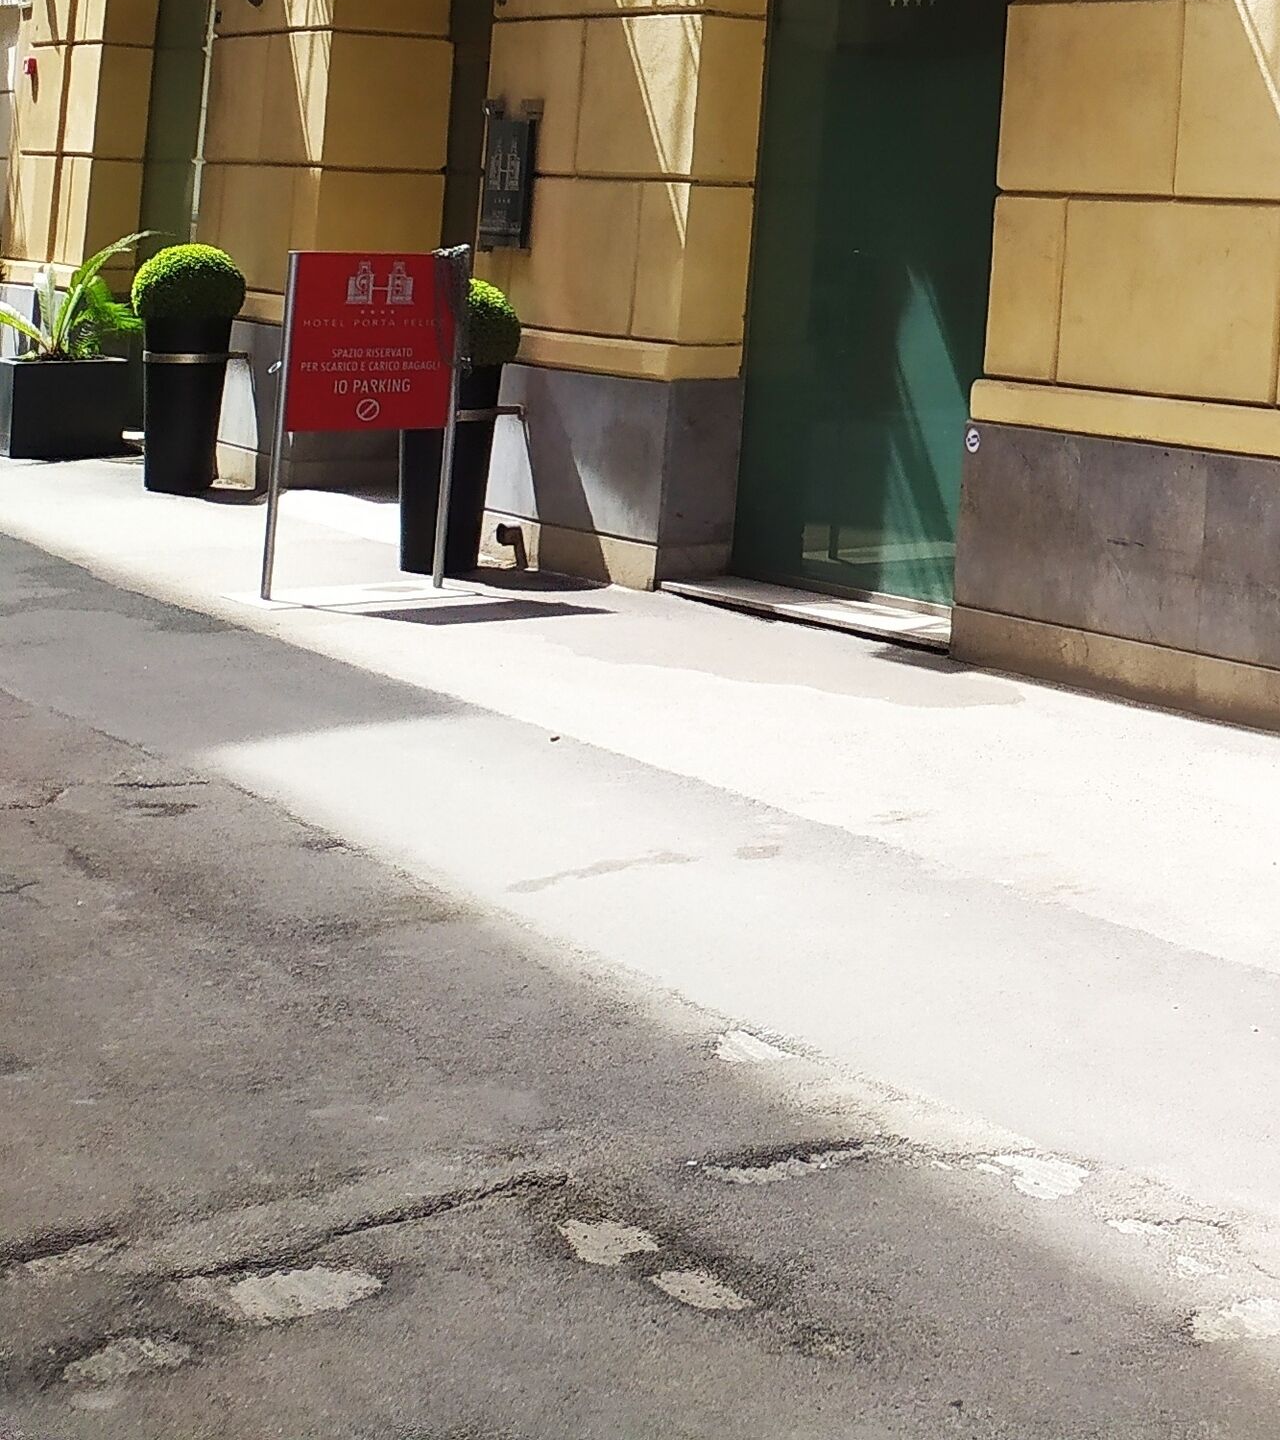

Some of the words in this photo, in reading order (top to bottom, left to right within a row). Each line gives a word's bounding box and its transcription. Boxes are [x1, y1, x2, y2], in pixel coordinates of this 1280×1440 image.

[303, 318, 345, 329] HOTEL
[353, 318, 396, 328] PORTA
[403, 317, 445, 327] FELIC
[331, 347, 364, 359] SPAZIO
[366, 346, 414, 359] RISERVATO
[300, 361, 319, 372] PER
[321, 361, 359, 372] SCARICO
[360, 361, 367, 372] E
[368, 360, 400, 372] CARICO
[402, 360, 441, 371] BAGAGLI
[352, 378, 411, 393] PARKING
